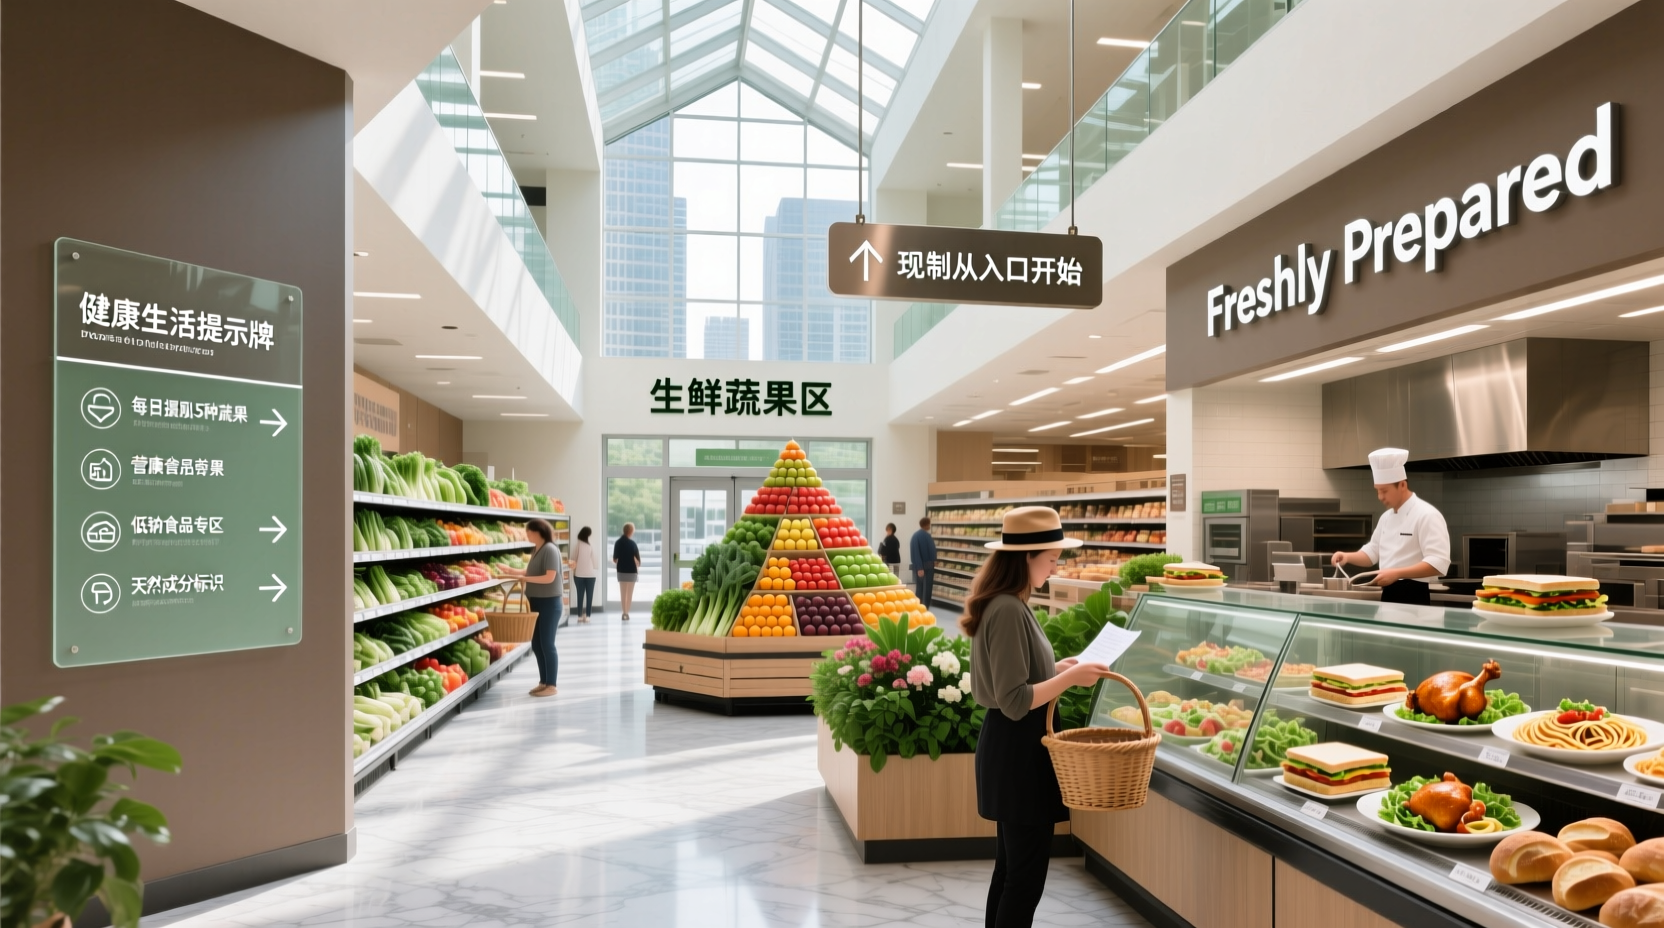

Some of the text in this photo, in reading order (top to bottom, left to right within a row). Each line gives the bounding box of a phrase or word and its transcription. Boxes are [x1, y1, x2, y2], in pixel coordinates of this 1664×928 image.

[1207, 101, 1617, 337] Freshly Prepared
[897, 250, 1083, 287] 现制从入口开始
[79, 291, 275, 350] 健康生活提示牌
[650, 377, 833, 417] 生鲜蔬果区
